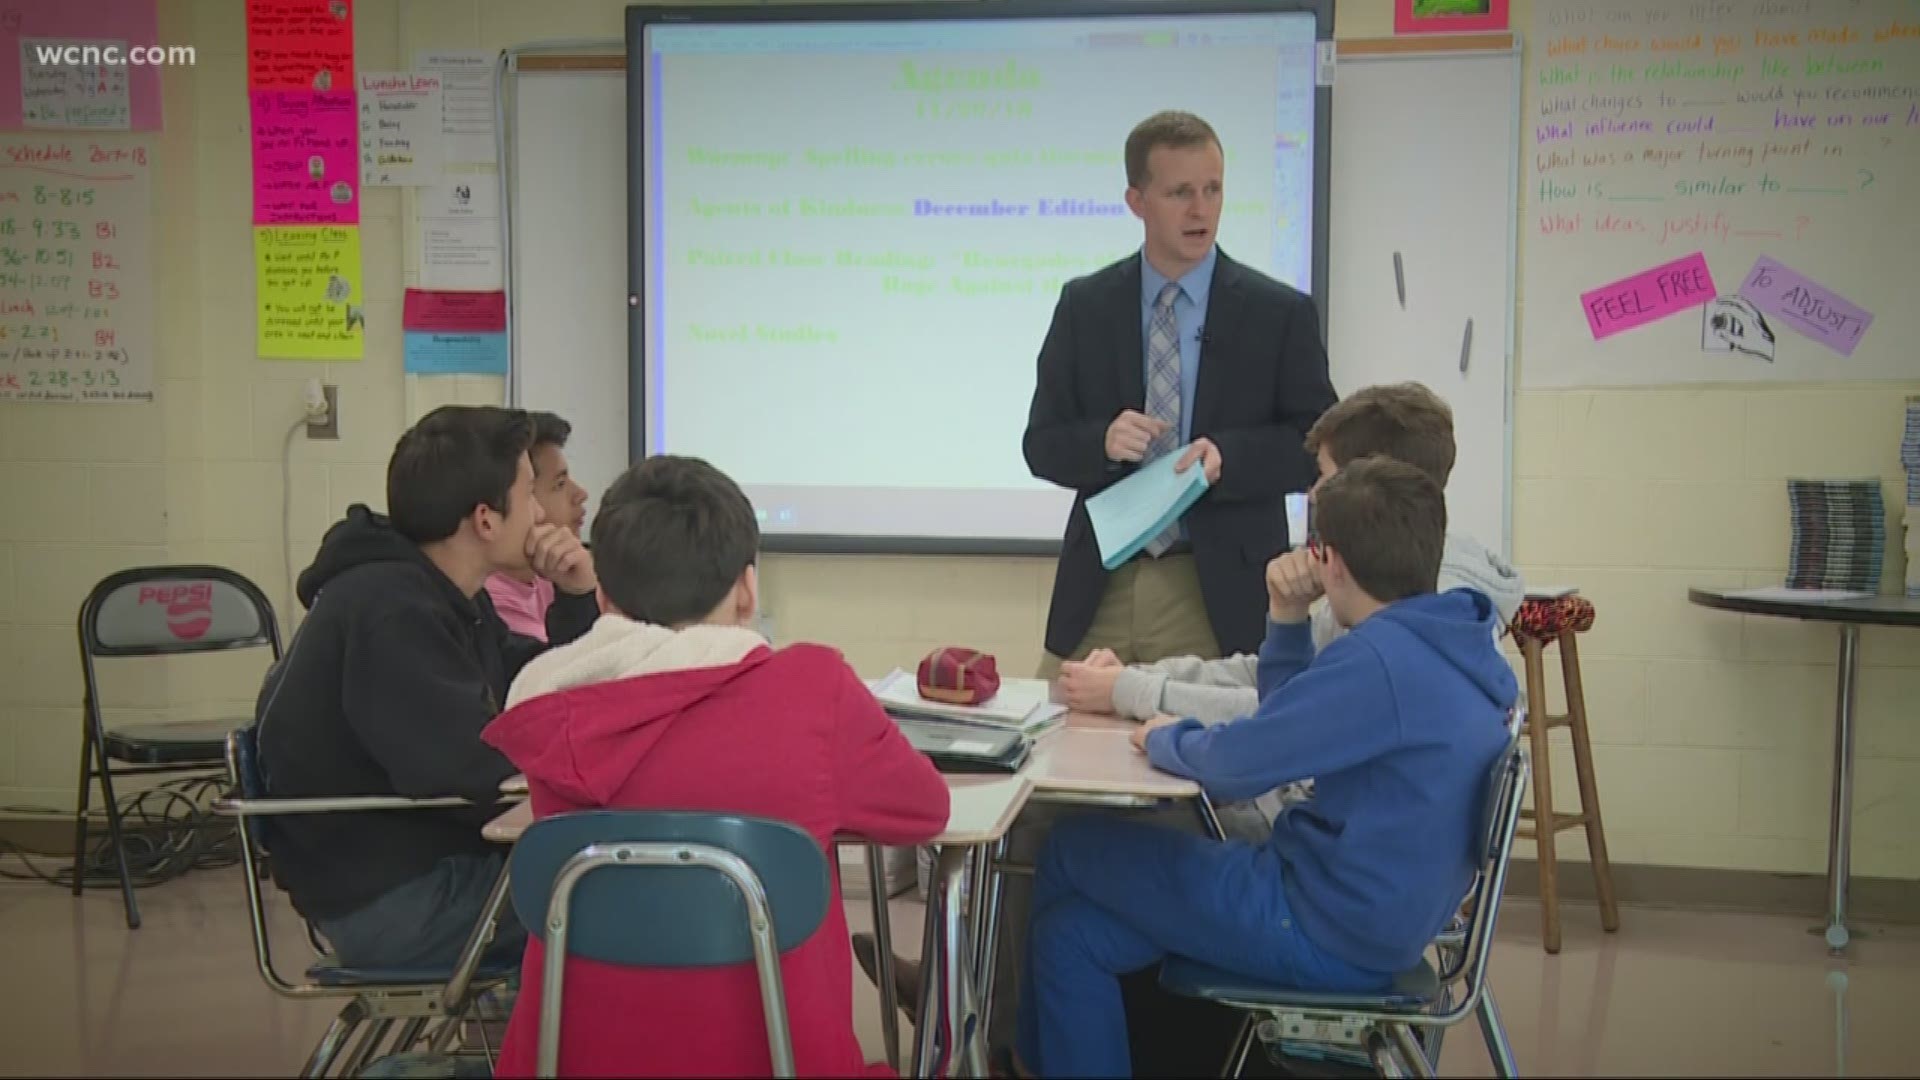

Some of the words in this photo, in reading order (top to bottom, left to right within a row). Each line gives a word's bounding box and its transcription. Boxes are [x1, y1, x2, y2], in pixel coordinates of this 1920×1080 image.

[890, 57, 1042, 94] Agenda
[1664, 115, 1715, 137] could
[1773, 107, 1818, 131] have
[1539, 178, 1577, 203] How
[1674, 174, 1747, 197] similar
[1758, 172, 1782, 195] to
[1856, 167, 1876, 191] ?
[913, 198, 1031, 217] December
[1037, 198, 1123, 217] Edition
[1540, 211, 1581, 236] What
[1589, 290, 1655, 329] FEEL
[1655, 266, 1710, 304] FREE
